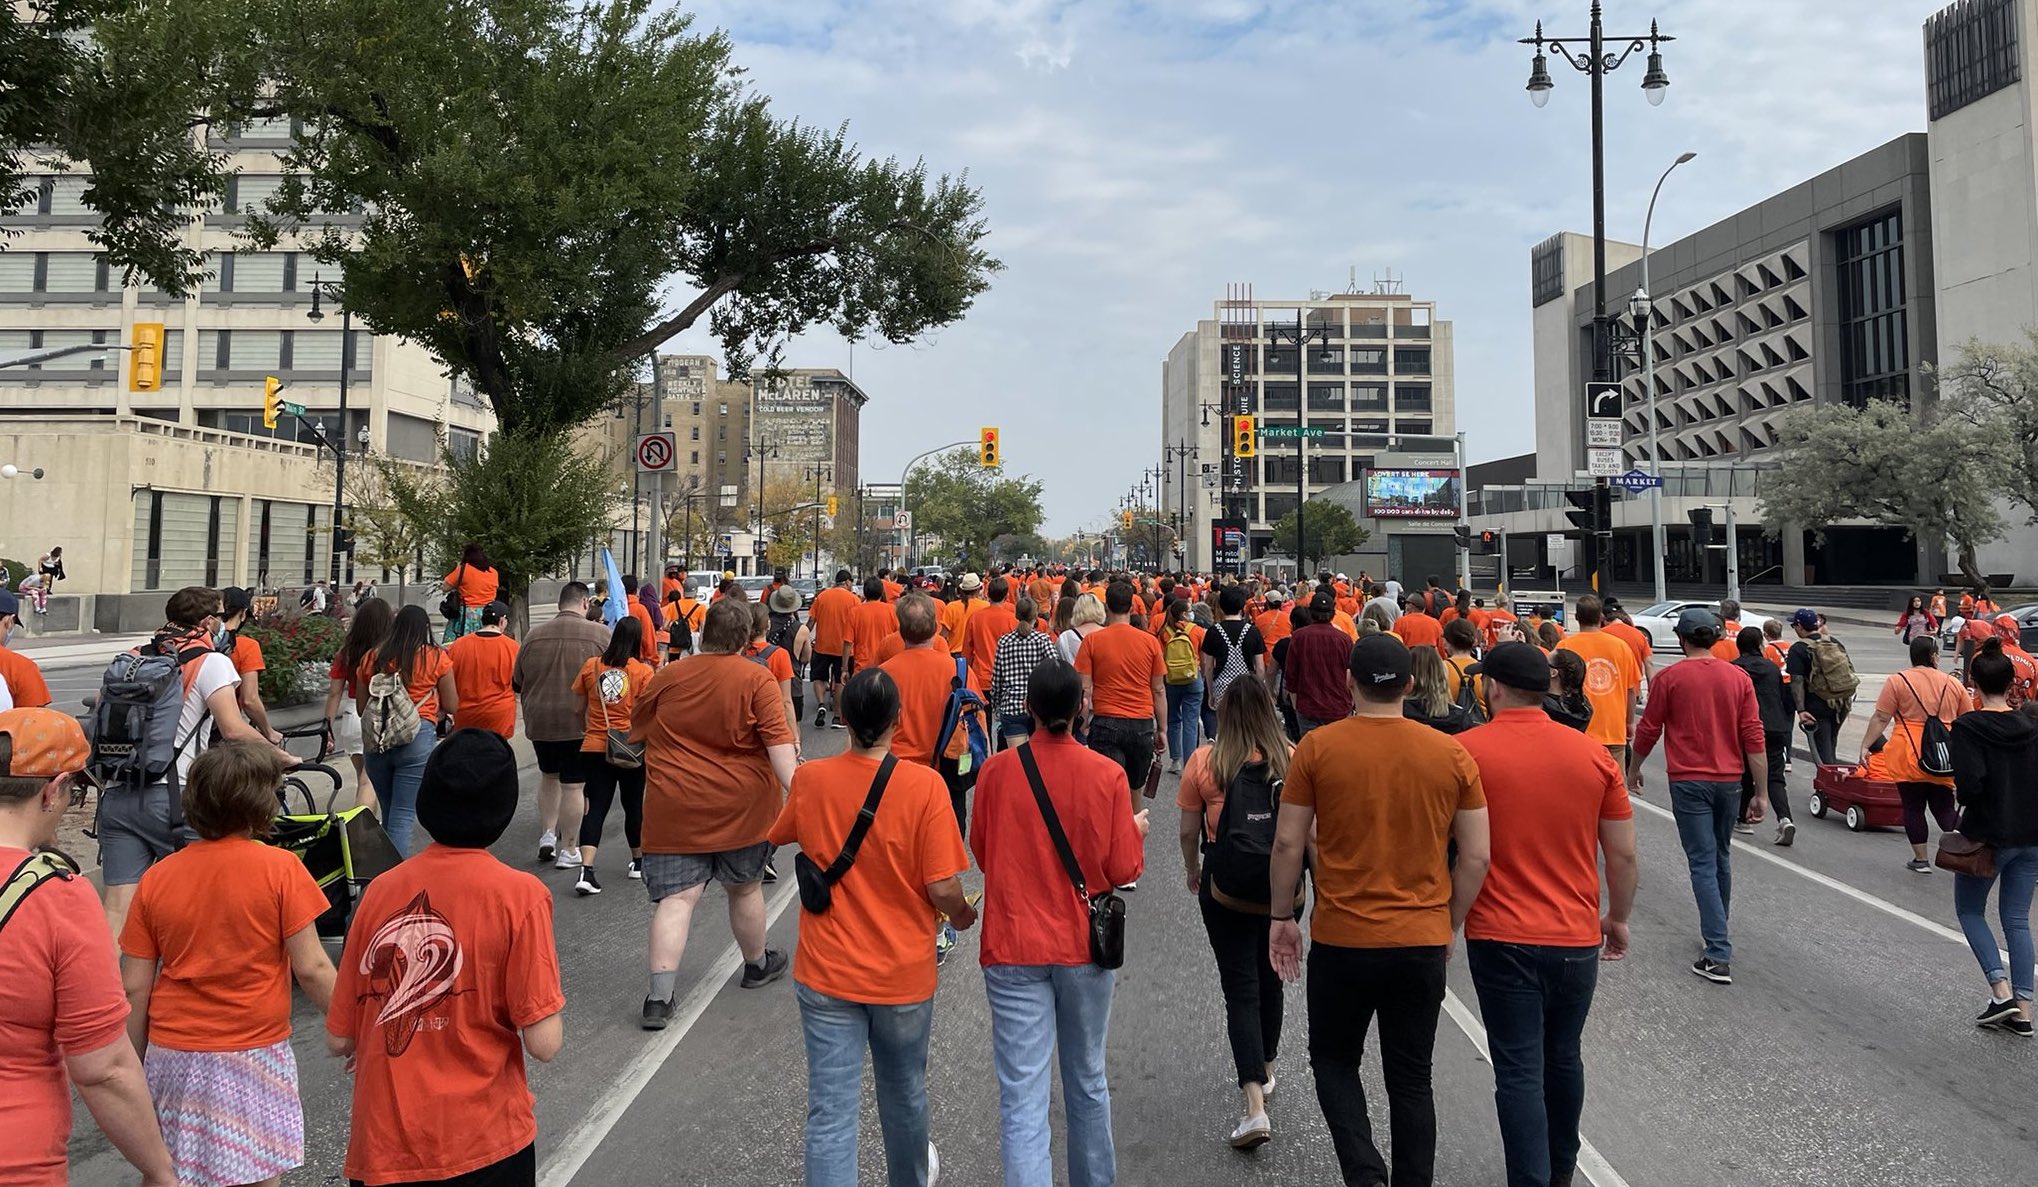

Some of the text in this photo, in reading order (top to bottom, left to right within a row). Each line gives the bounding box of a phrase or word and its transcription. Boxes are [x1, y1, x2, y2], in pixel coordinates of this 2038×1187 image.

[1232, 345, 1241, 385] SCIENCE
[758, 388, 820, 401] McLAREN
[1260, 429, 1323, 437] Market Ave
[1615, 478, 1657, 486] MARKET
